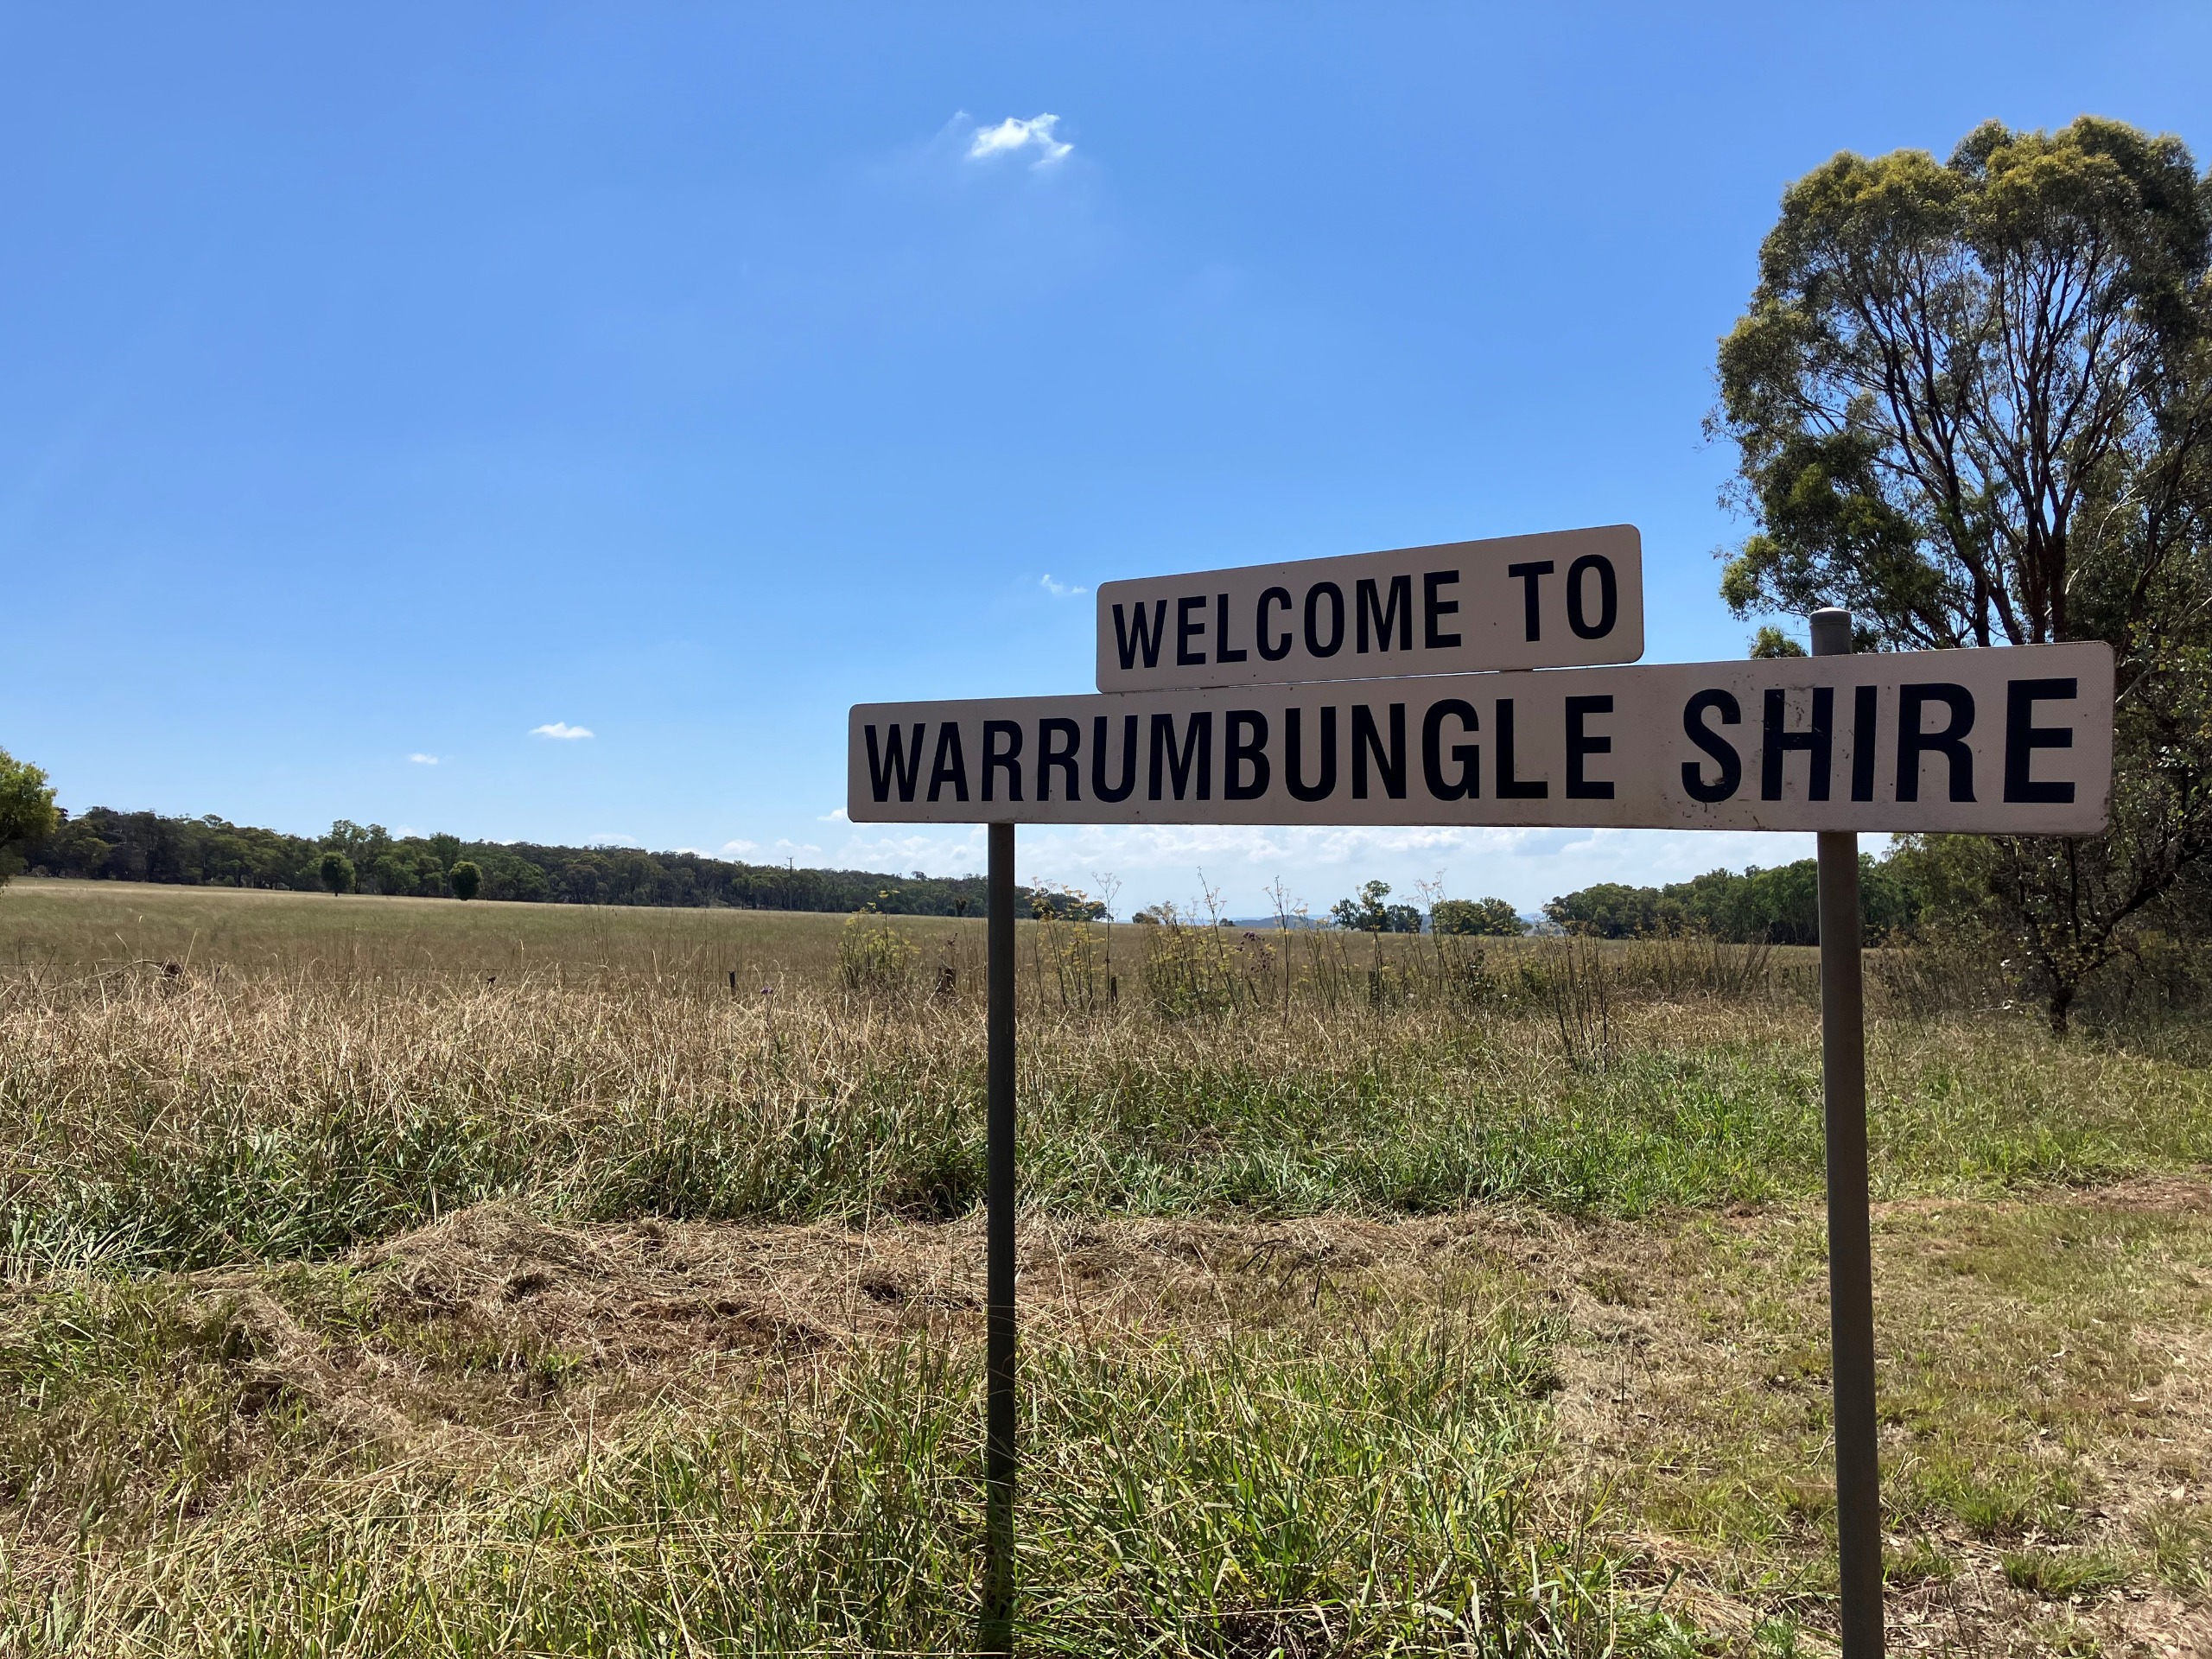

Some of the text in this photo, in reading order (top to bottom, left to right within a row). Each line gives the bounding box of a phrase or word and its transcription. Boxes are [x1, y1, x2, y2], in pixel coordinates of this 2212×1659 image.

[1111, 554, 1618, 671] WELCOME TO
[863, 677, 2079, 805] WARRUMBUNGLE SHIRE
